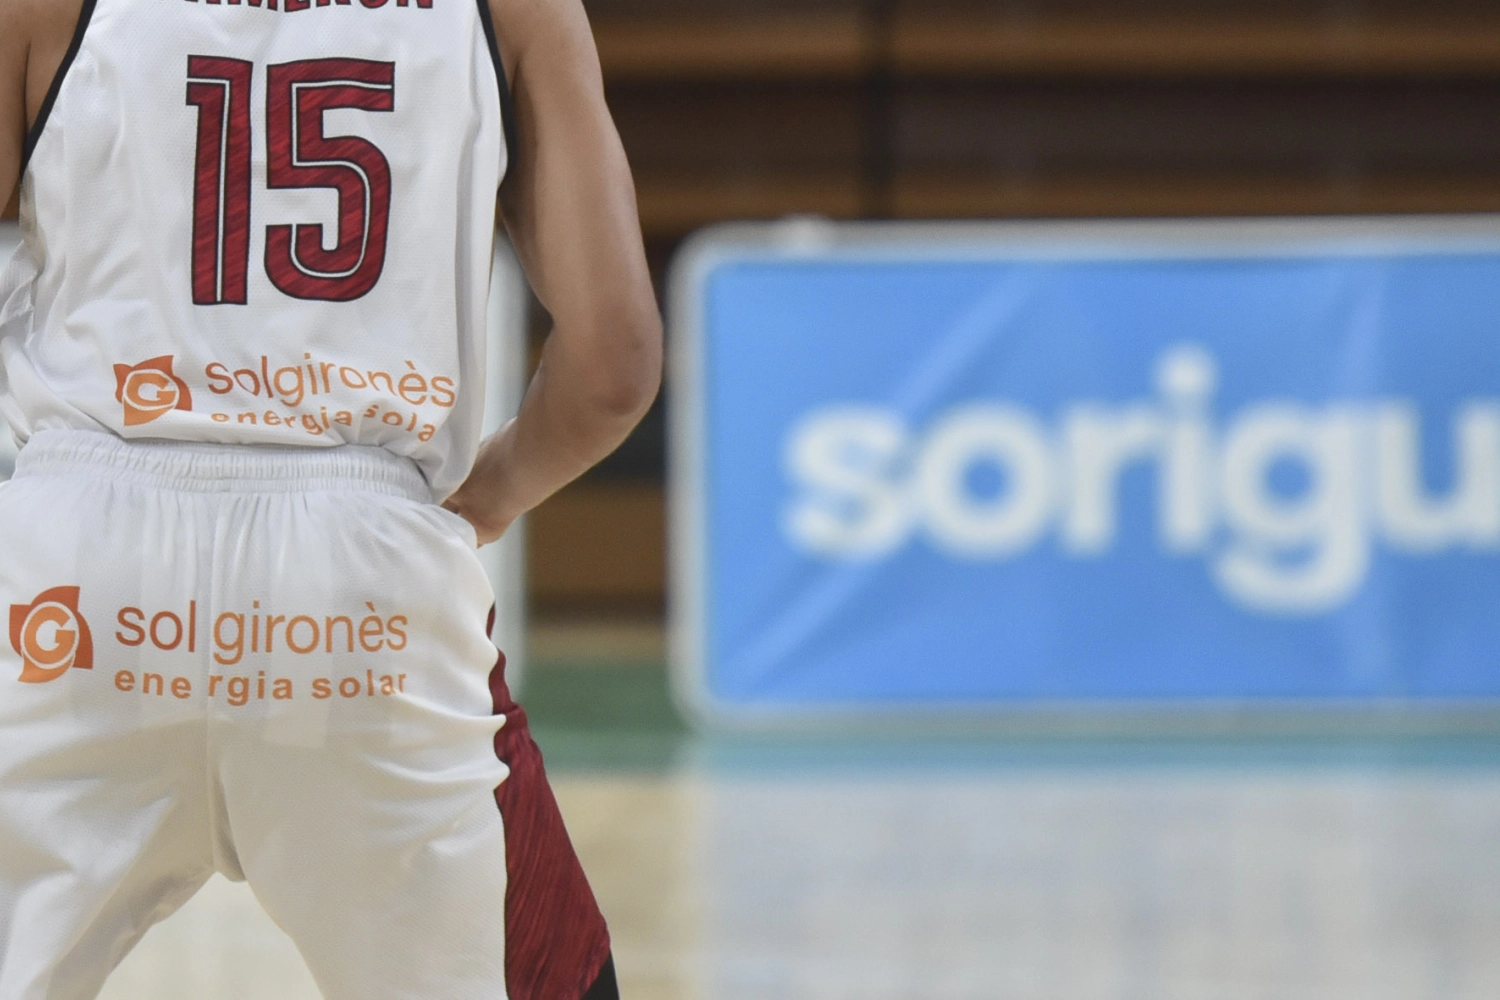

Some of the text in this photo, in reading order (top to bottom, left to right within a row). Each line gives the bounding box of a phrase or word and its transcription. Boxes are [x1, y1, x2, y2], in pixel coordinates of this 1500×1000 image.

[186, 54, 396, 306] 15
[780, 341, 1500, 616] sorigu
[114, 669, 407, 706] energia solar
